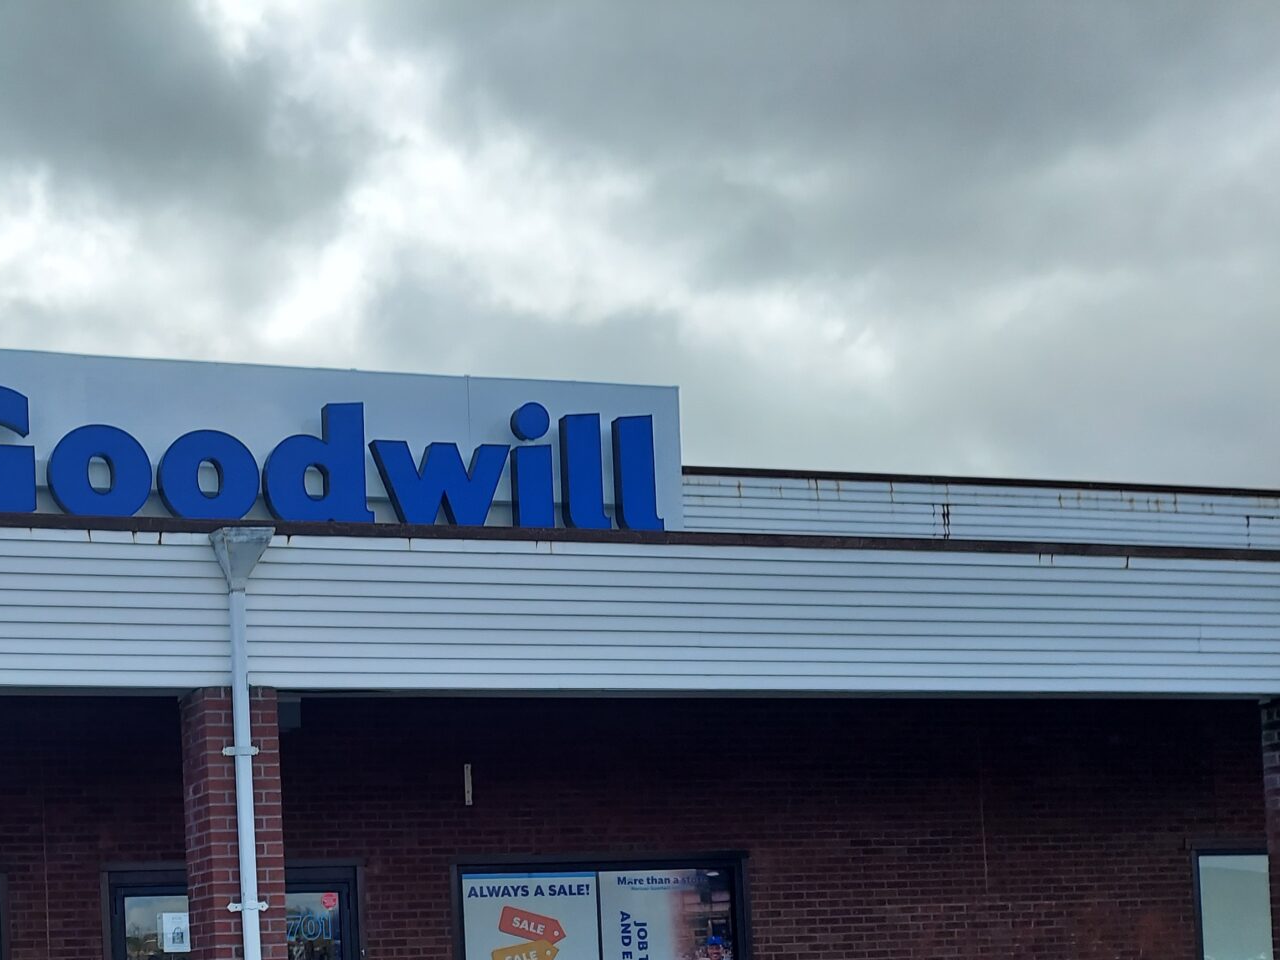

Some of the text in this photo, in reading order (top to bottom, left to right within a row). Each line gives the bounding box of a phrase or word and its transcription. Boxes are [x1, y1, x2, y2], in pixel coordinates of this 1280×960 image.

[617, 876, 644, 885] More
[646, 876, 670, 885] than
[468, 884, 590, 898] ALWAYS A SALE!
[512, 917, 545, 935] SALE
[620, 911, 632, 946] AND
[634, 921, 648, 951] JOB
